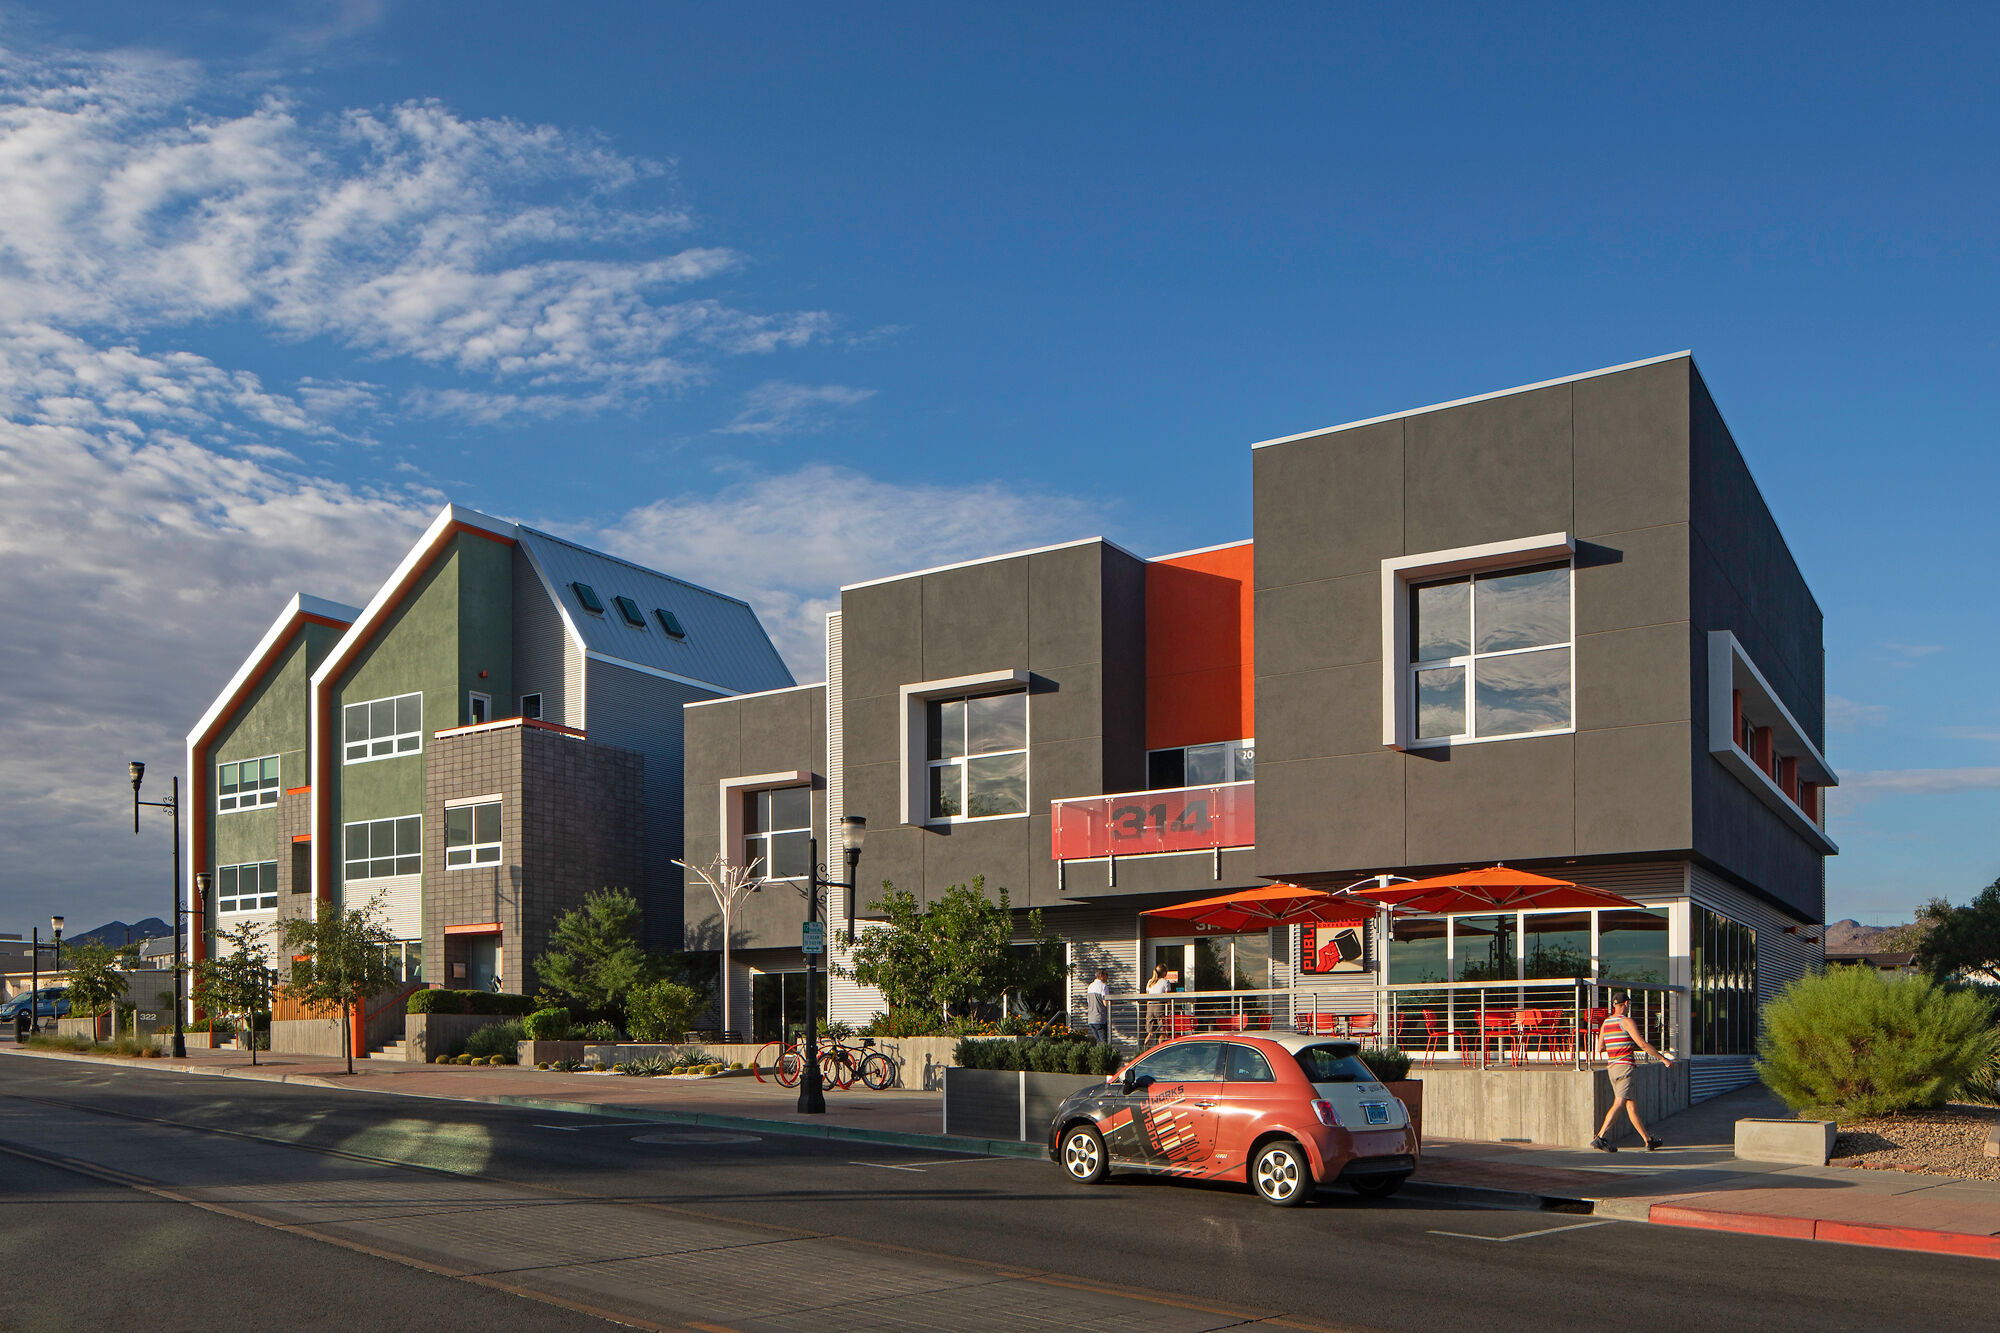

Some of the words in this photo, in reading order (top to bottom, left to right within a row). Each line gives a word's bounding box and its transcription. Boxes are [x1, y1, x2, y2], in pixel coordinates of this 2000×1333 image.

[1112, 800, 1213, 840] 314
[140, 1013, 157, 1021] 322
[1151, 1085, 1184, 1105] WORKS
[1140, 1099, 1162, 1151] PUBLIC
